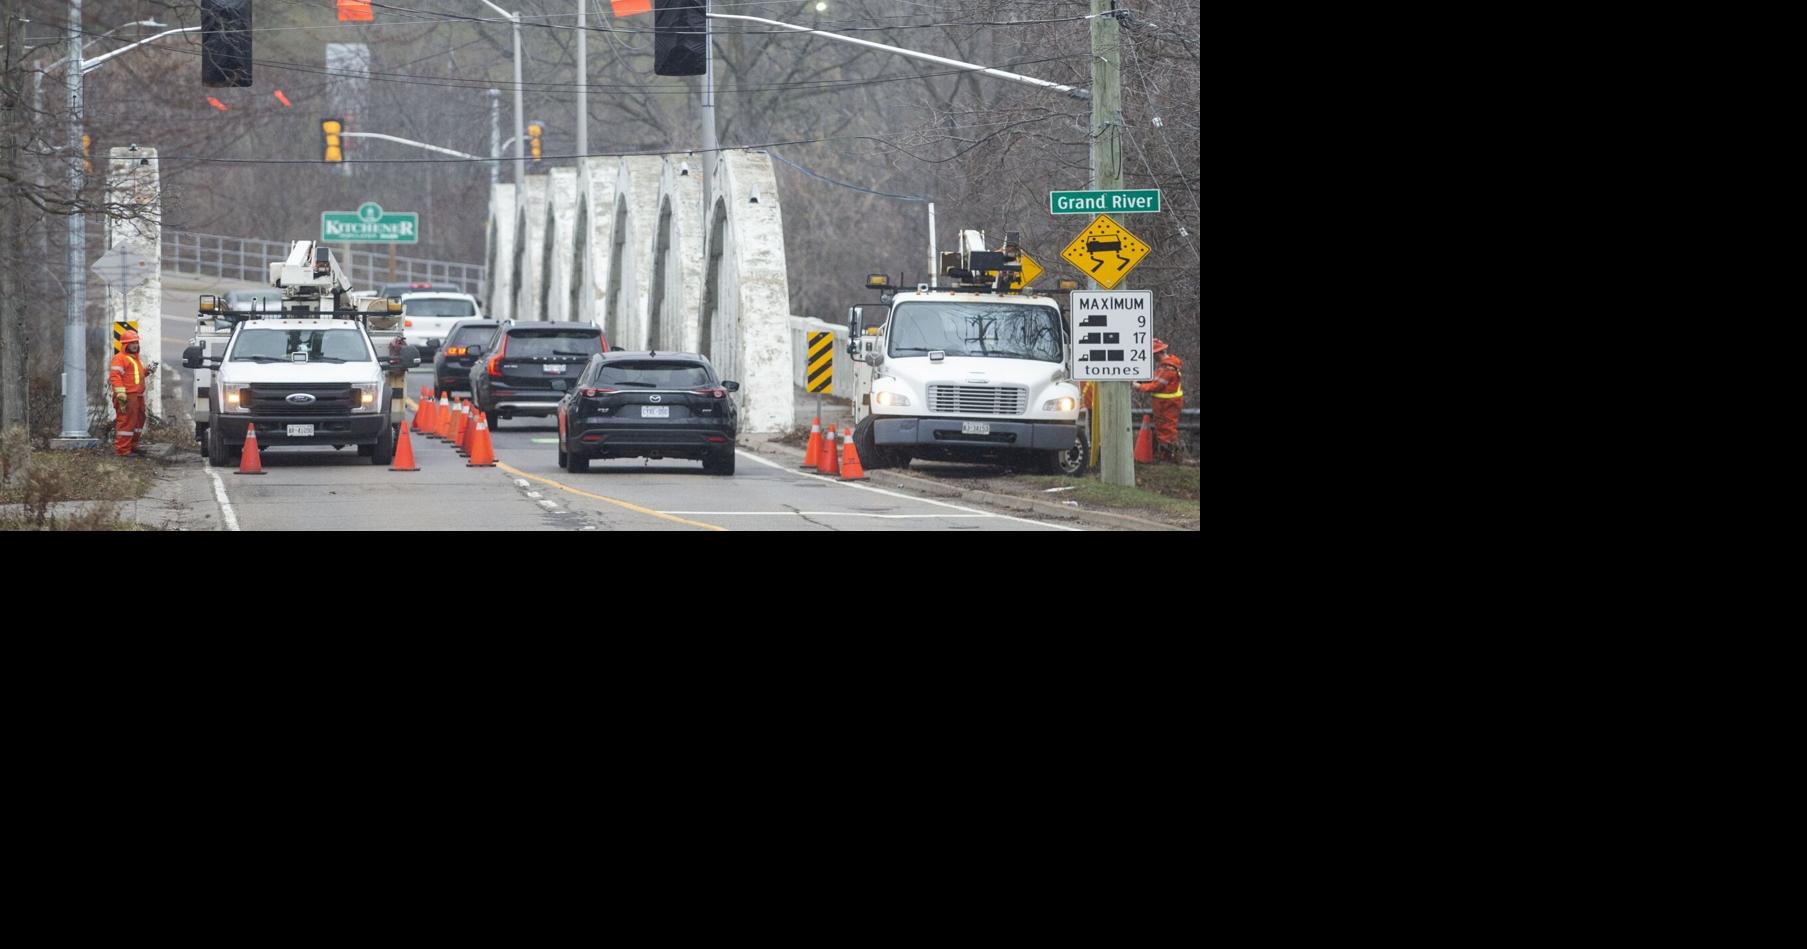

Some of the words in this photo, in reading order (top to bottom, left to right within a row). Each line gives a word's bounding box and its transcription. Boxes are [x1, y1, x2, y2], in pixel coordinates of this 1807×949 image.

[1057, 193, 1105, 210] Grand
[1112, 194, 1153, 209] River
[325, 220, 414, 235] KITCHENER
[1079, 297, 1144, 310] MAXIMUM
[1137, 315, 1146, 328] 9
[1132, 331, 1146, 345] 17
[1130, 349, 1147, 362] 24
[1085, 365, 1140, 376] tonnes
